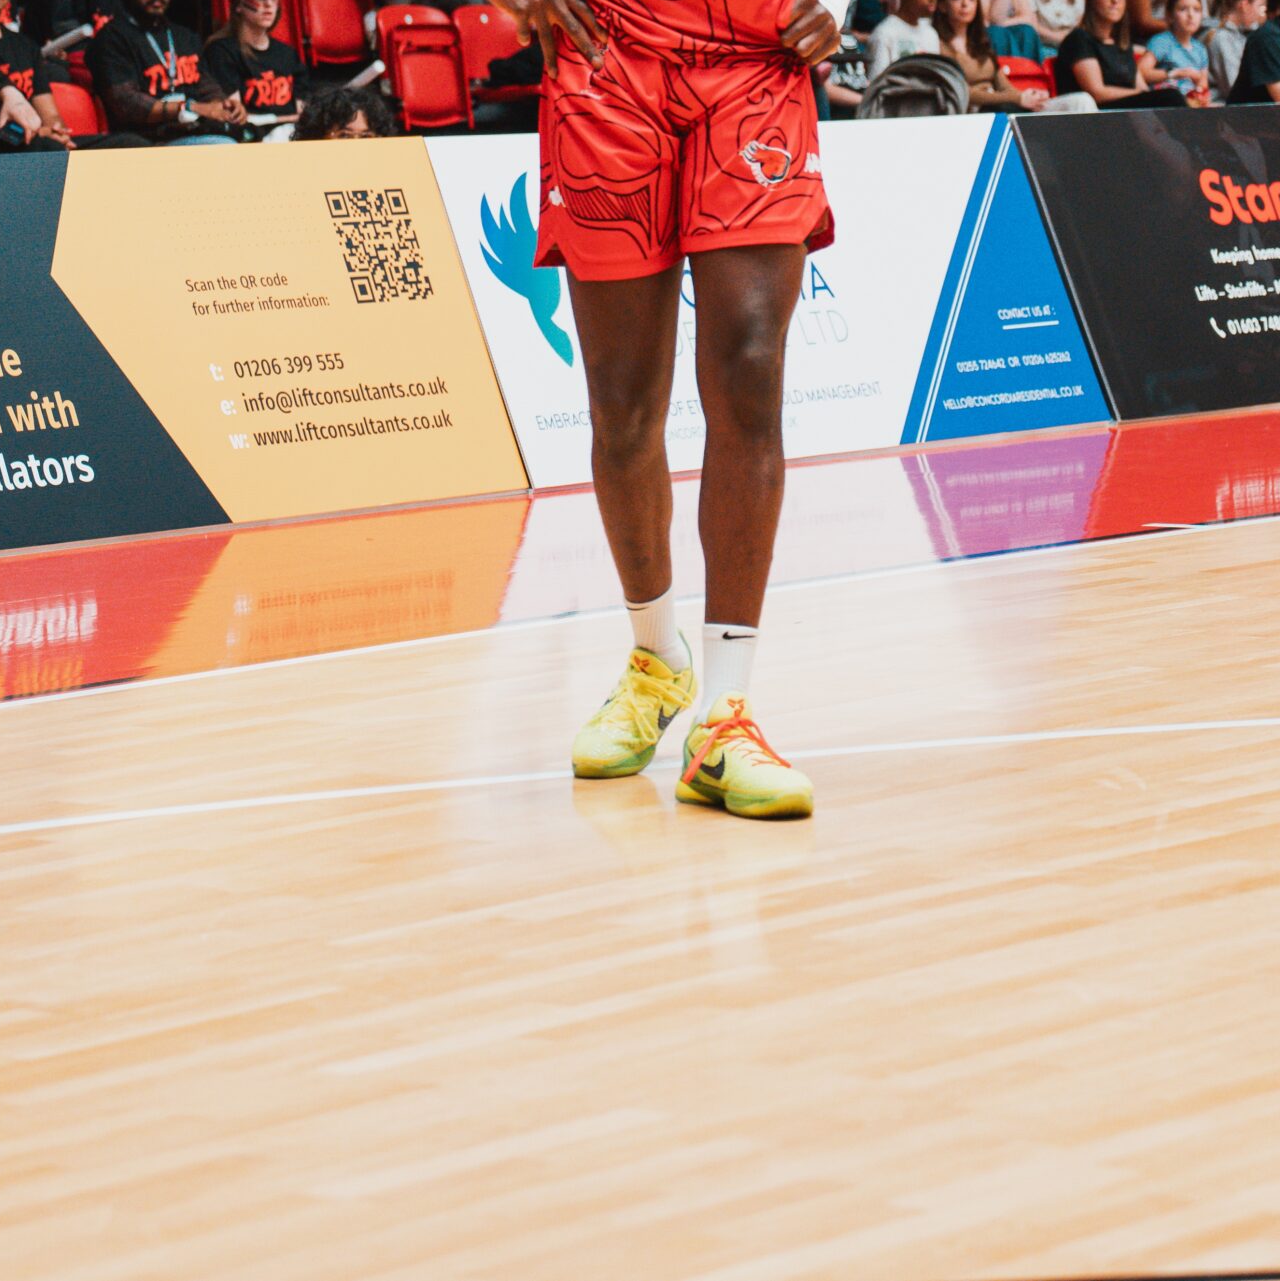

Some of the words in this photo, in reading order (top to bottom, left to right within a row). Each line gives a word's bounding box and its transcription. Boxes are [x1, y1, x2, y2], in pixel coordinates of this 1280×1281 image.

[1210, 246, 1255, 266] Keeping
[185, 279, 215, 293] Scan
[217, 276, 237, 291] the
[239, 275, 258, 290] QR
[260, 272, 289, 287] code
[1194, 283, 1219, 302] Lifts
[1224, 281, 1268, 300] Stairlifts
[192, 301, 210, 316] for
[212, 297, 256, 315] further
[258, 293, 331, 312] information:
[997, 306, 1031, 321] CONTACT
[1032, 305, 1043, 317] US
[797, 308, 850, 347] LTD
[1227, 316, 1261, 336] 01603
[208, 362, 225, 381] t:
[233, 357, 282, 379] 01206
[284, 354, 313, 375] 399
[316, 352, 345, 371] 555
[1008, 356, 1020, 368] OR
[220, 399, 237, 416] e:
[242, 376, 449, 414] info@liftconsultants.co.uk
[805, 380, 882, 402] MANAGEMENT
[6, 390, 80, 433] with
[229, 432, 250, 449] w:
[253, 409, 454, 447] www.liftconsultants.co.uk
